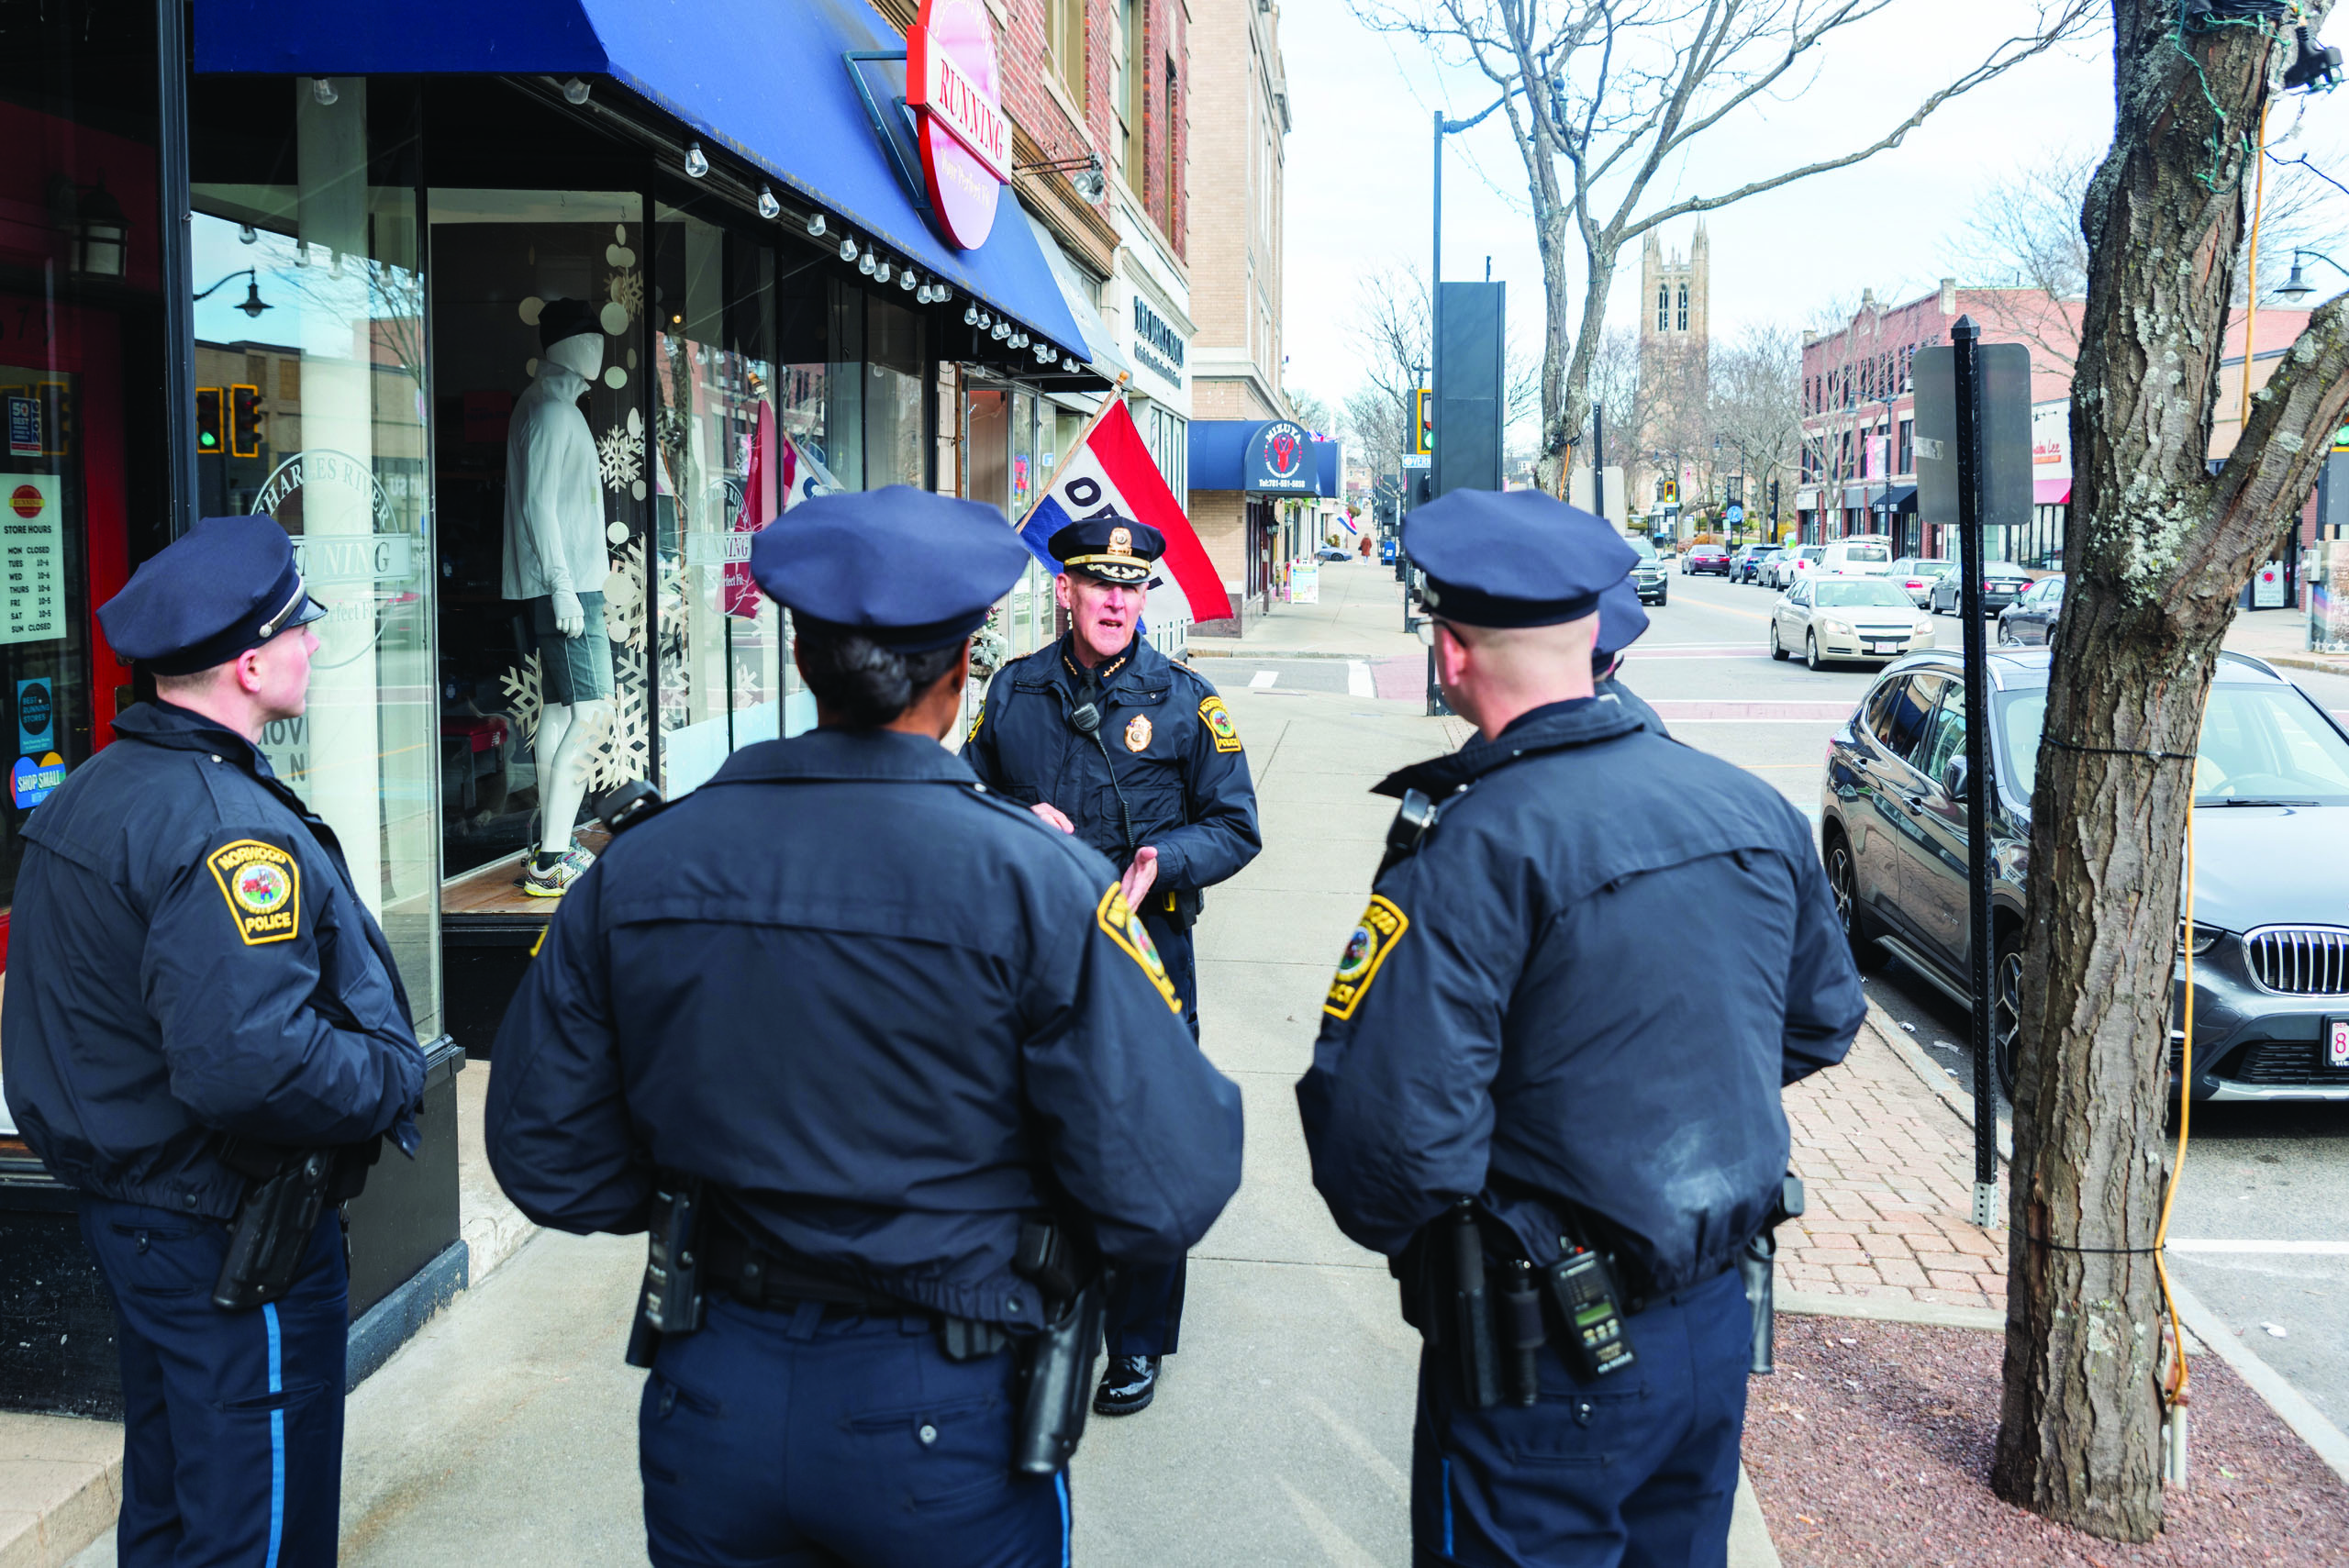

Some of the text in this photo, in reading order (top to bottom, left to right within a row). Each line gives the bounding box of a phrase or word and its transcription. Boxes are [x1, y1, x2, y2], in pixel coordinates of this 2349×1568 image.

[939, 58, 1004, 161] RUNNING
[1265, 423, 1301, 445] MIZUYA
[257, 457, 337, 517] HARLES
[4, 525, 52, 534] STORE HOURS
[27, 546, 50, 554] CLOSED
[8, 560, 24, 568] TUES
[9, 573, 23, 581] WED
[10, 585, 29, 594] THURS
[11, 612, 23, 620] SAT
[11, 622, 51, 633] SUN CLOSED
[22, 696, 38, 706] BEST
[22, 704, 50, 715] RUNNING
[22, 713, 46, 724] STORES
[17, 770, 61, 793] SHOP SMALL
[217, 846, 286, 872] NORWOOD
[245, 911, 292, 934] POLICE
